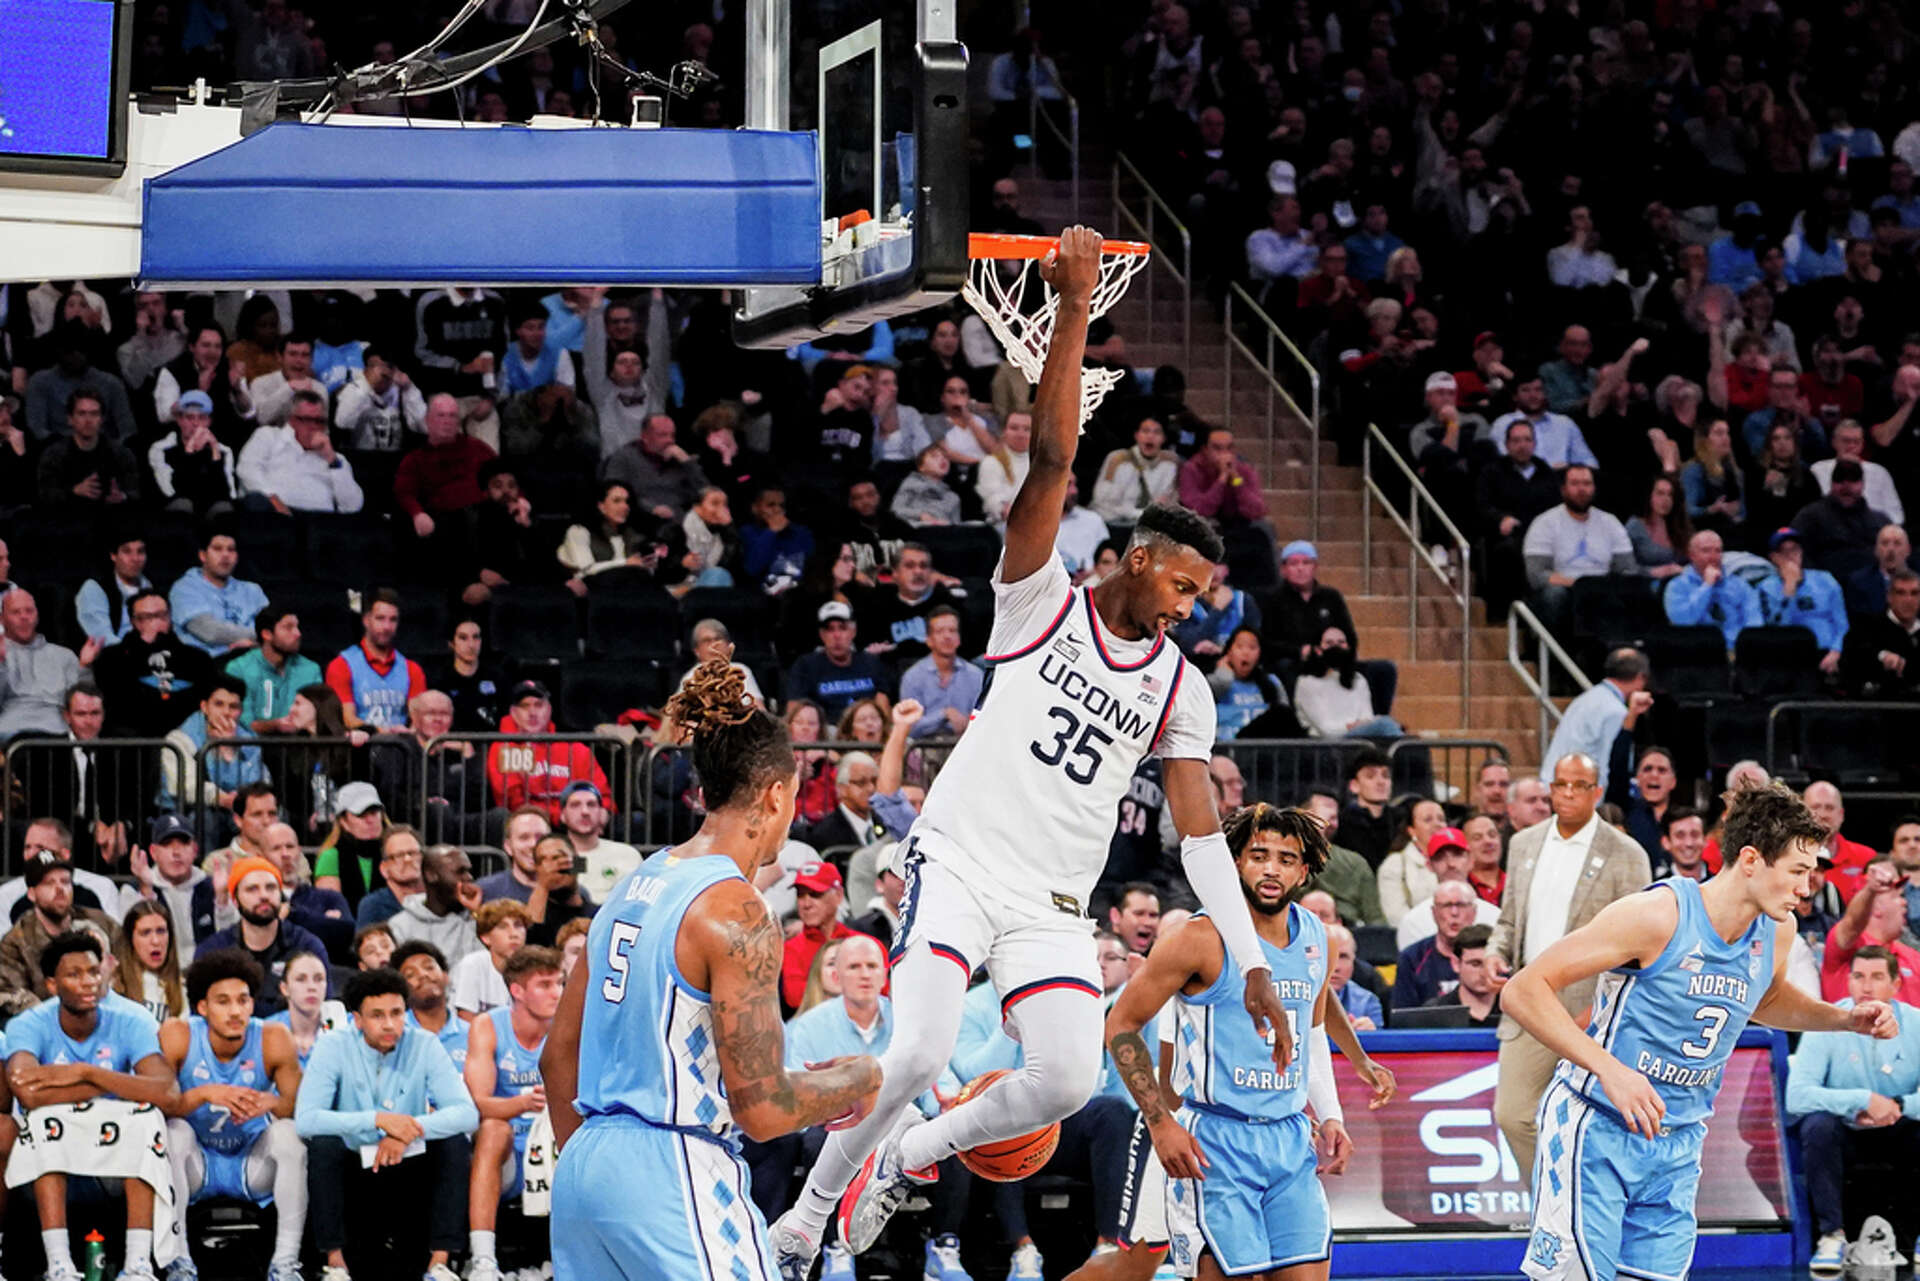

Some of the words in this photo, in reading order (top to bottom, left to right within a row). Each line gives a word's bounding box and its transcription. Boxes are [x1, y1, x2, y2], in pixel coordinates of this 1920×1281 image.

[1038, 653, 1151, 740] UCONN
[500, 746, 533, 772] 108
[1030, 706, 1114, 786] 35
[1120, 800, 1147, 836] 34
[602, 919, 642, 1004] 5
[1271, 978, 1314, 1002] ORTH
[1687, 974, 1749, 1003] NORTH
[1680, 1004, 1731, 1059] 3
[208, 1104, 231, 1133] 7
[1431, 1190, 1532, 1215] DISTRI
